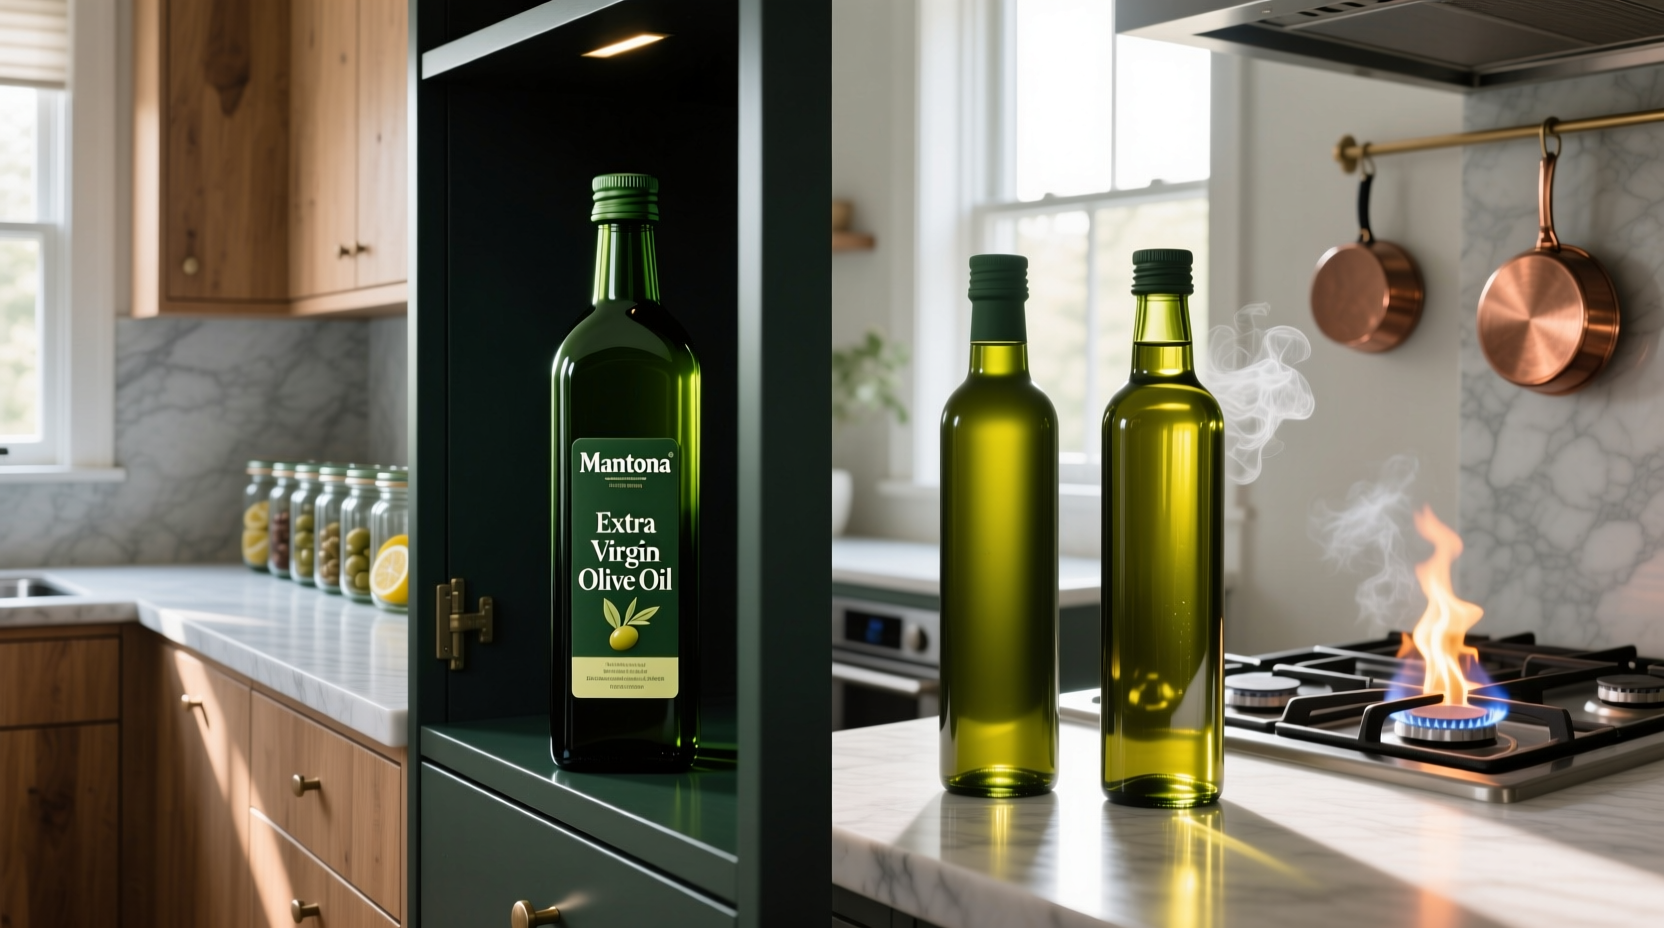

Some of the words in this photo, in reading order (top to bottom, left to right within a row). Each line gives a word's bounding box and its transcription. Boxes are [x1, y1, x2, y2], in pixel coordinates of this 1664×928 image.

[579, 451, 671, 473] Mantona
[595, 511, 657, 534] Extra
[590, 539, 661, 569] Virgin
[578, 567, 636, 591] Olive
[639, 567, 673, 591] Oil
